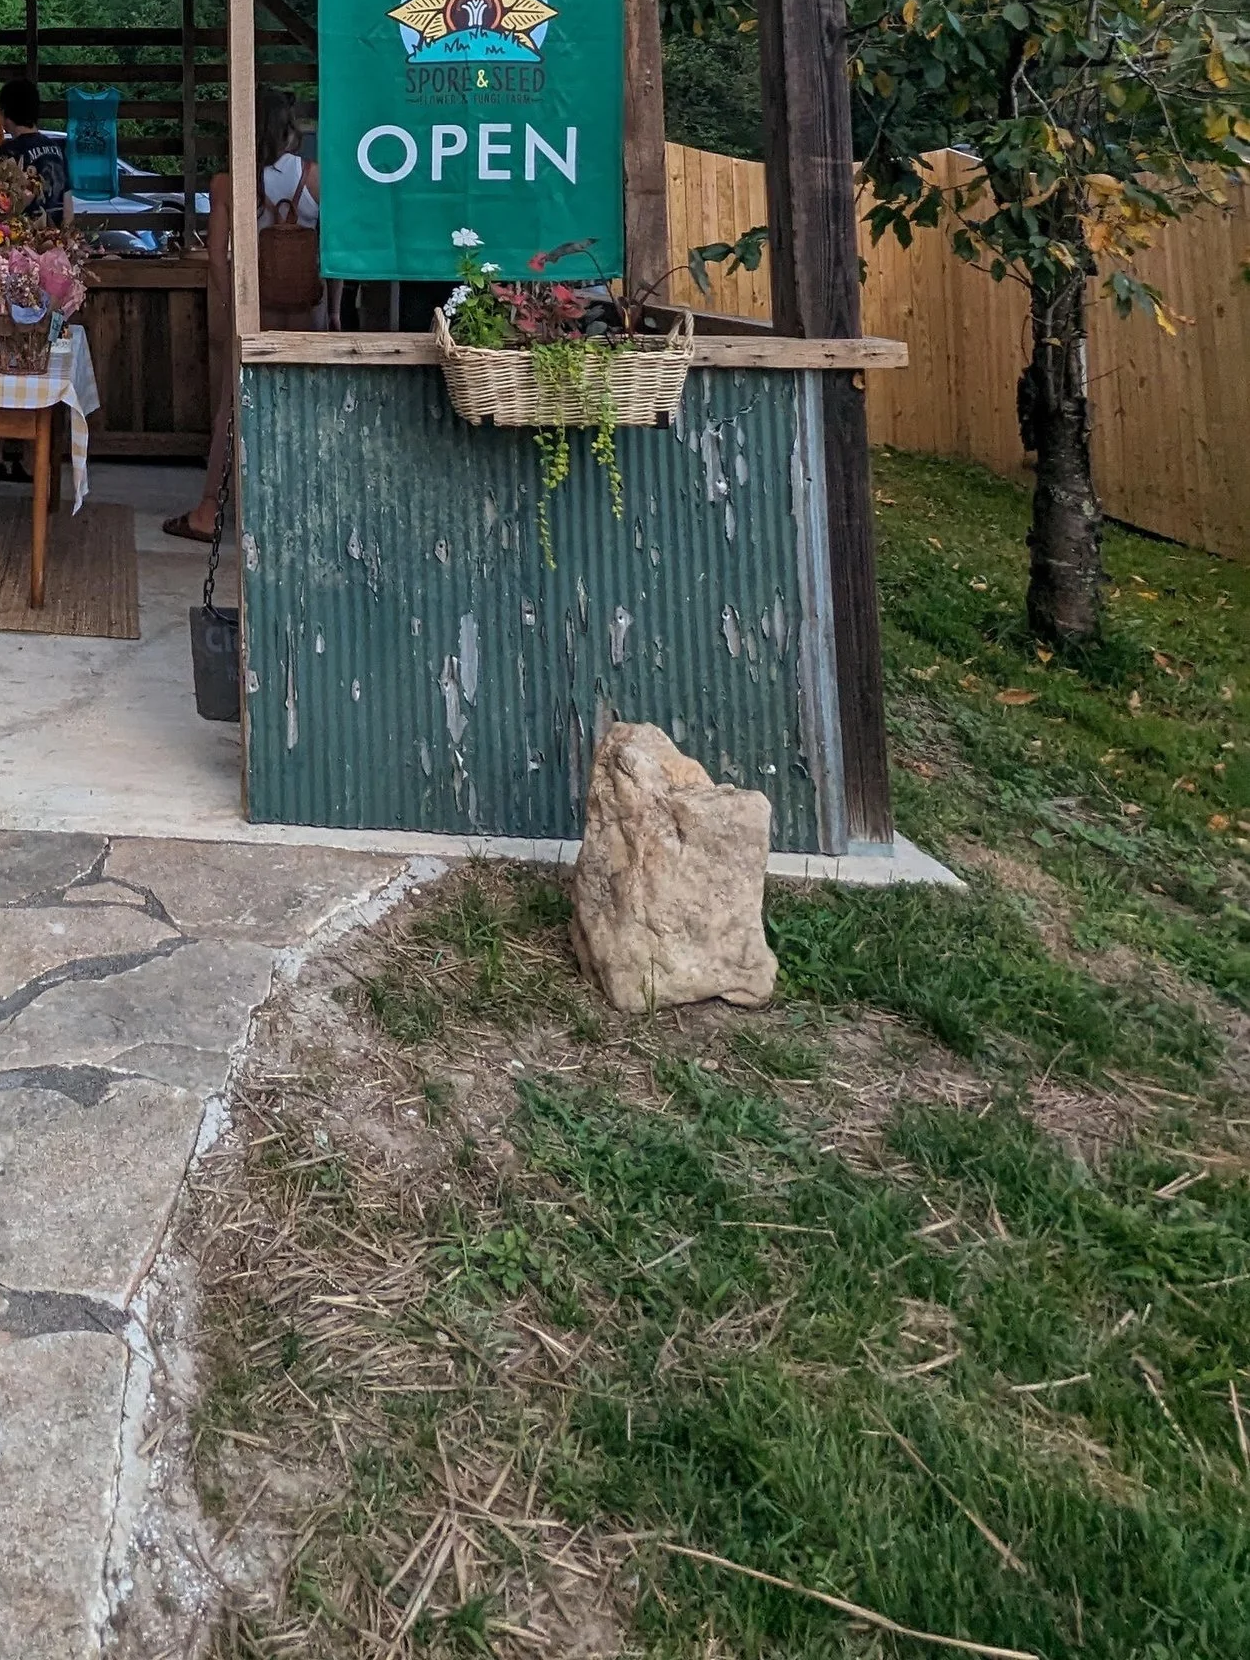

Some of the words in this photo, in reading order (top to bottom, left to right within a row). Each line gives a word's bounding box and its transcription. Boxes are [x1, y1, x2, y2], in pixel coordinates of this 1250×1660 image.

[406, 66, 473, 93] SPORE
[476, 69, 489, 88] &
[492, 66, 546, 92] SEED
[357, 123, 577, 185] OPEN
